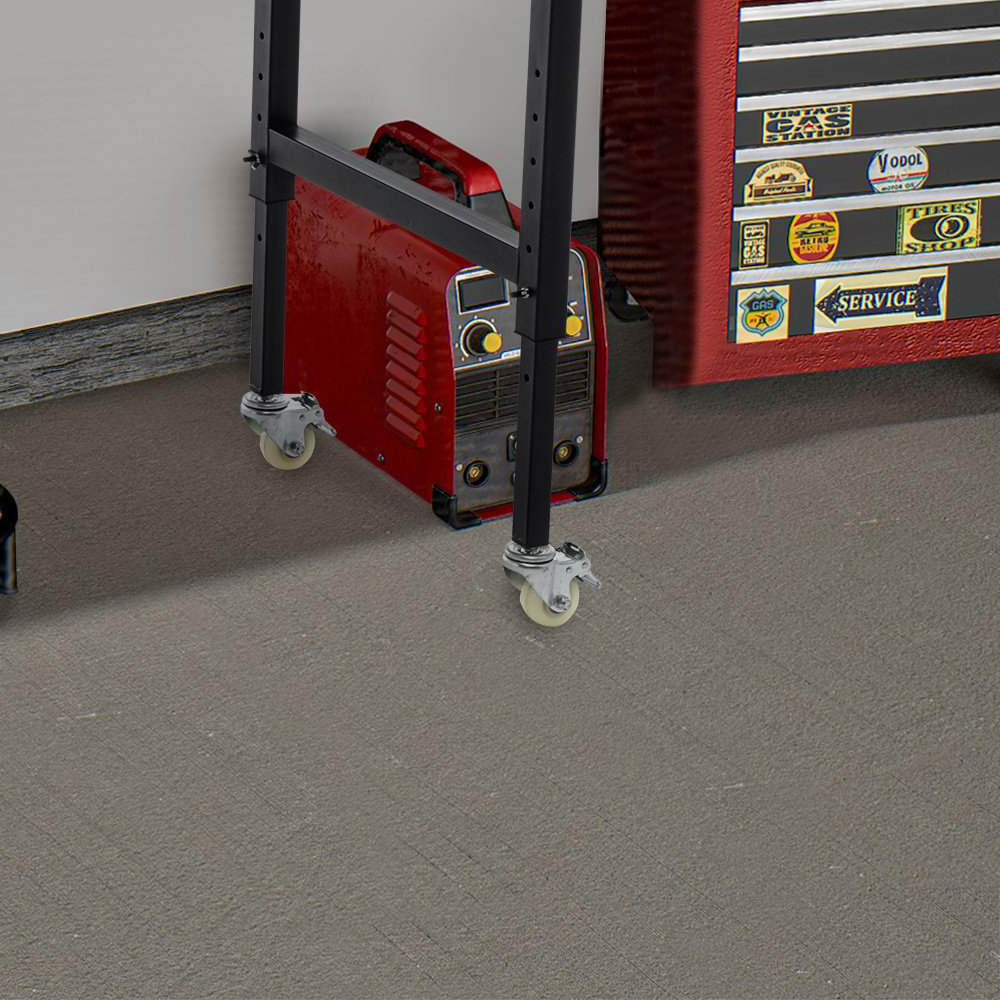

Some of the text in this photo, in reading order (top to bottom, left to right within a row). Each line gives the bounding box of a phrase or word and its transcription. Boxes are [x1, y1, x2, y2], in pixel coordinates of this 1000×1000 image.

[766, 105, 851, 119] VINTAGE
[765, 113, 851, 134] GAS
[765, 128, 850, 142] STATION
[877, 153, 923, 173] VODOL
[906, 202, 977, 219] TIRES
[905, 237, 976, 254] SHOP
[752, 299, 774, 311] GAS
[837, 290, 918, 311] SERVICE
